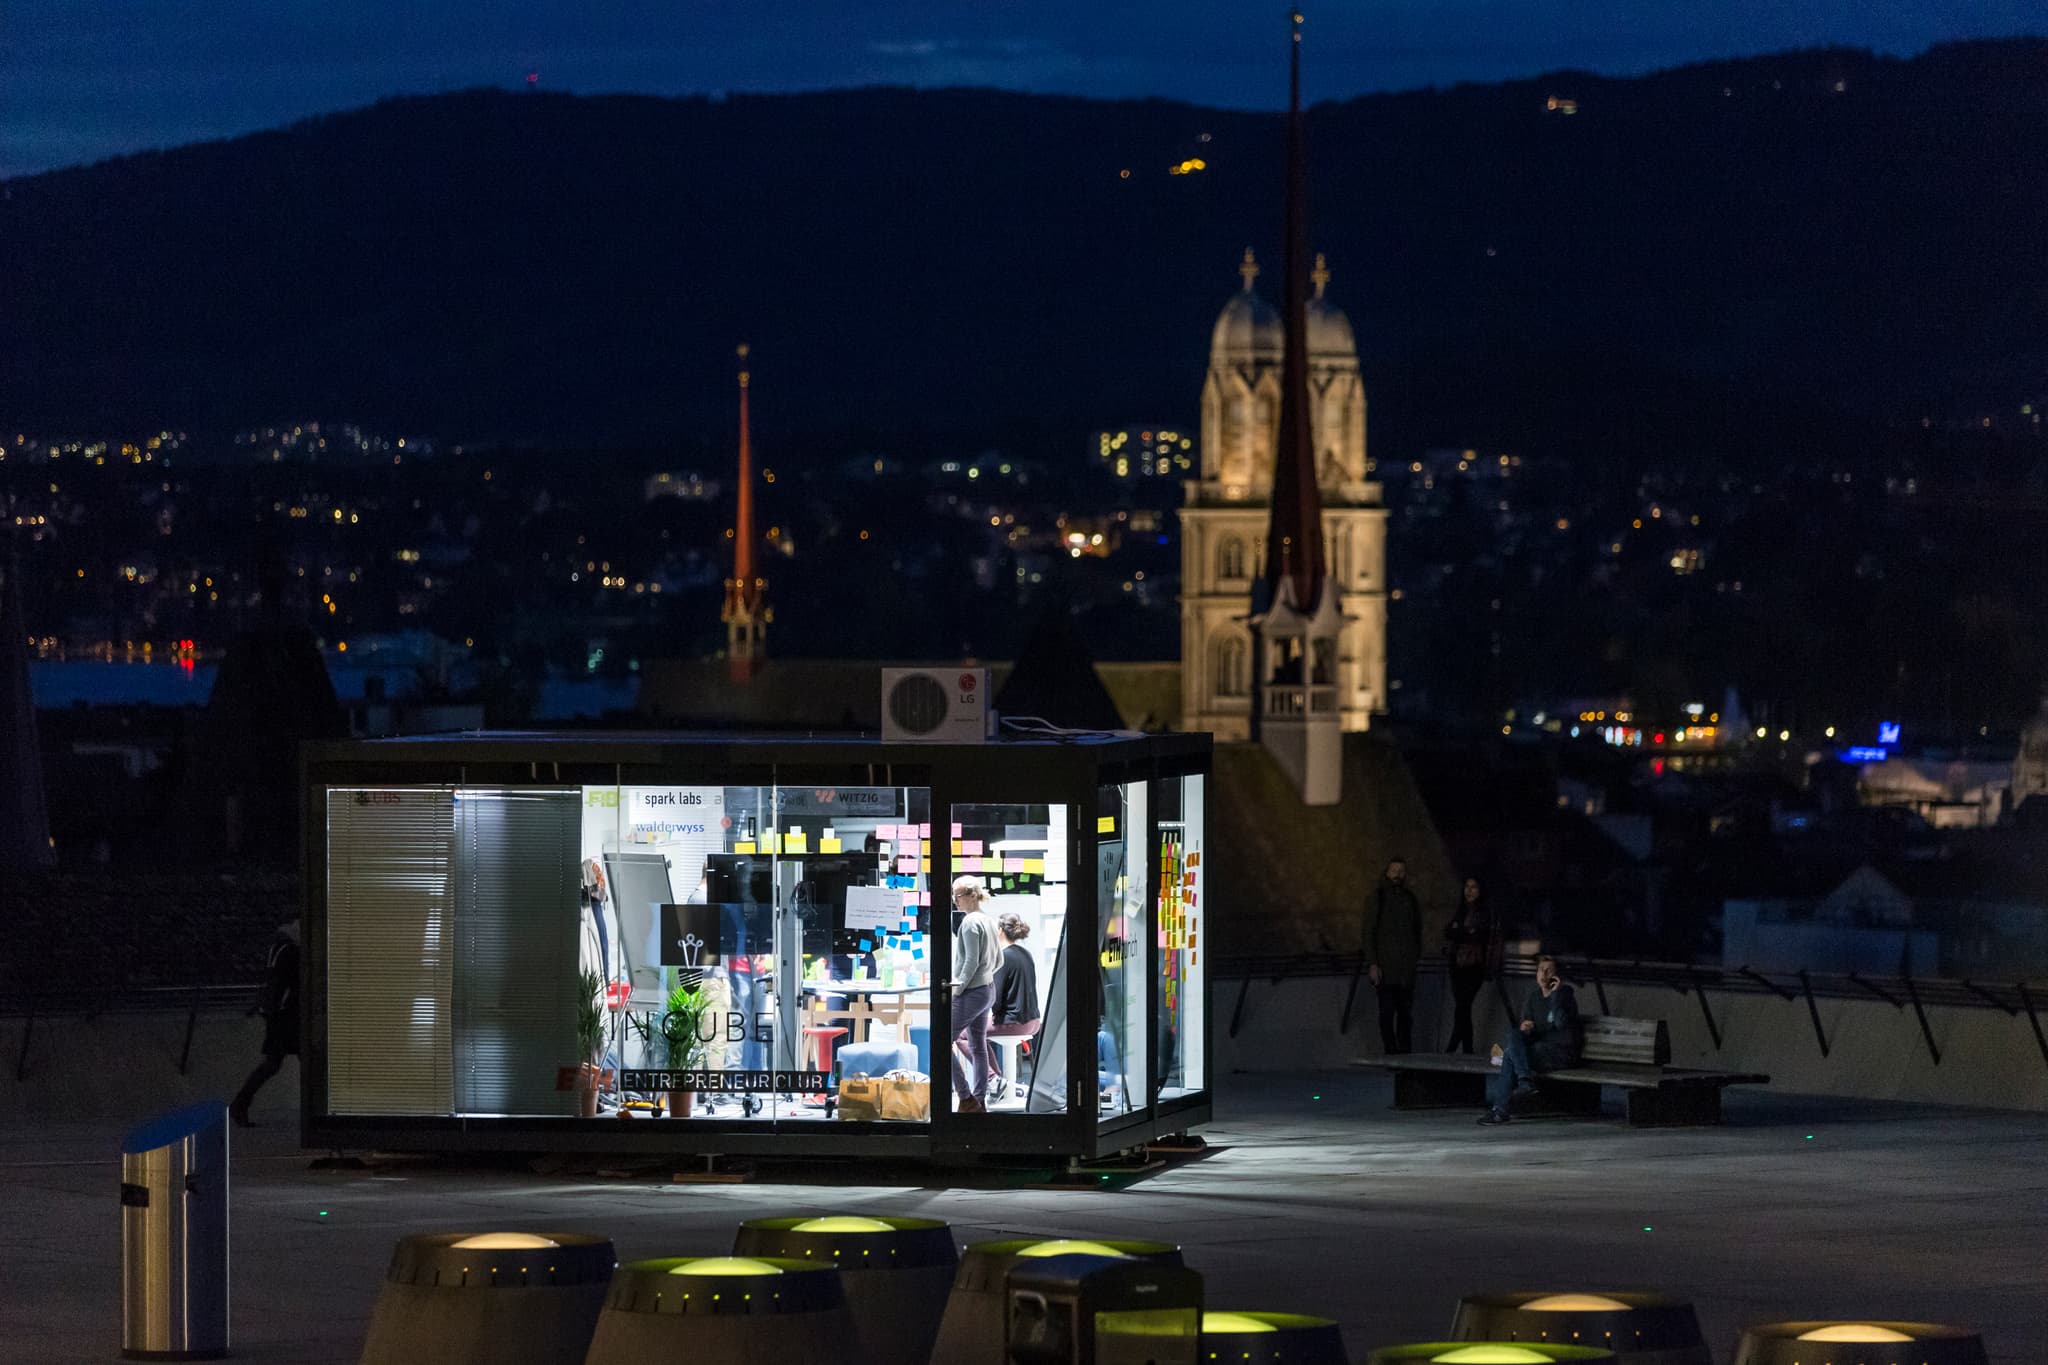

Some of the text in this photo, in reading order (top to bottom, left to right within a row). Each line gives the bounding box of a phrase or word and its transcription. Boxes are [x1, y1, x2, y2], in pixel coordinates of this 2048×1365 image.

[960, 694, 975, 704] LG
[645, 791, 675, 807] spark
[679, 791, 702, 805] labs
[838, 792, 879, 803] WITZIG
[636, 821, 705, 834] walderwyss
[623, 1072, 770, 1090] ENTREPRENEUR
